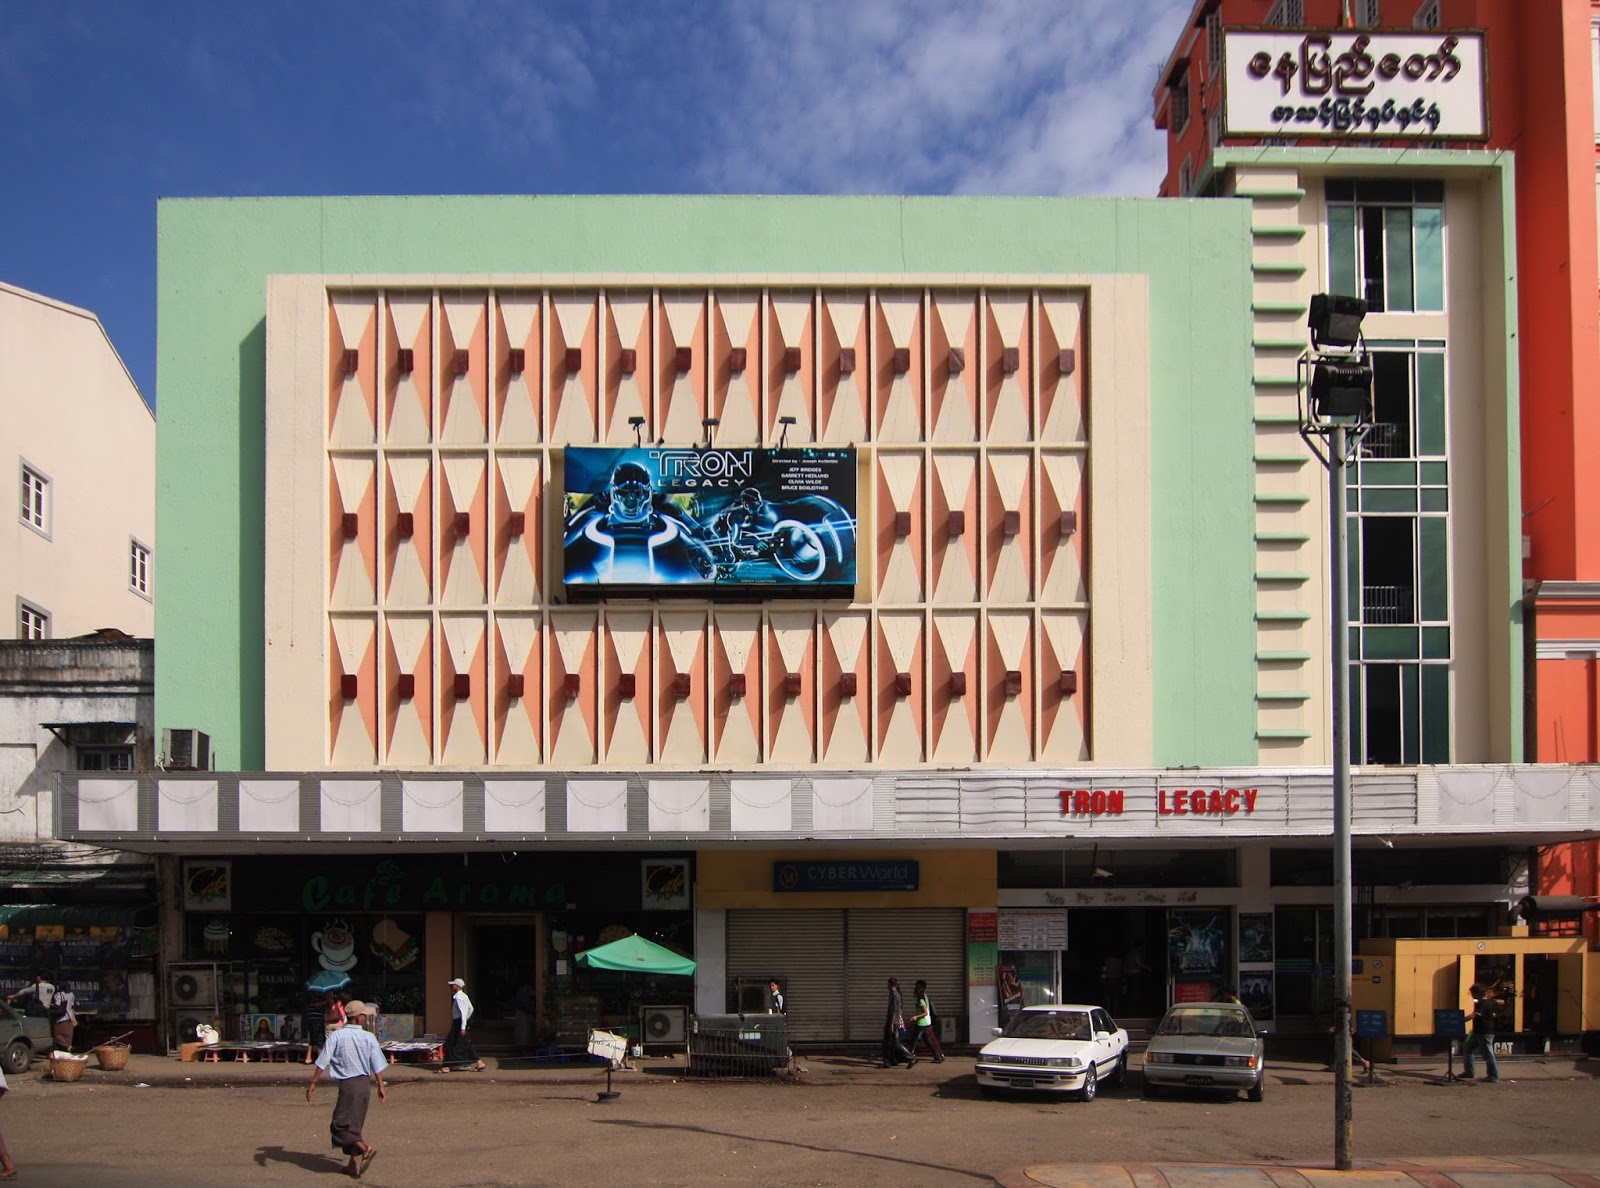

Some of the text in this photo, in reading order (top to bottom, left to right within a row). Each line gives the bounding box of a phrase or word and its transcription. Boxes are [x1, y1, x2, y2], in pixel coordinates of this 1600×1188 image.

[649, 451, 752, 477] TRON
[658, 479, 745, 487] LEGACY
[1058, 788, 1258, 815] TRON LEGACY
[421, 873, 569, 906] Aroma
[259, 975, 296, 984] SALADS
[1494, 1041, 1514, 1055] CAT
